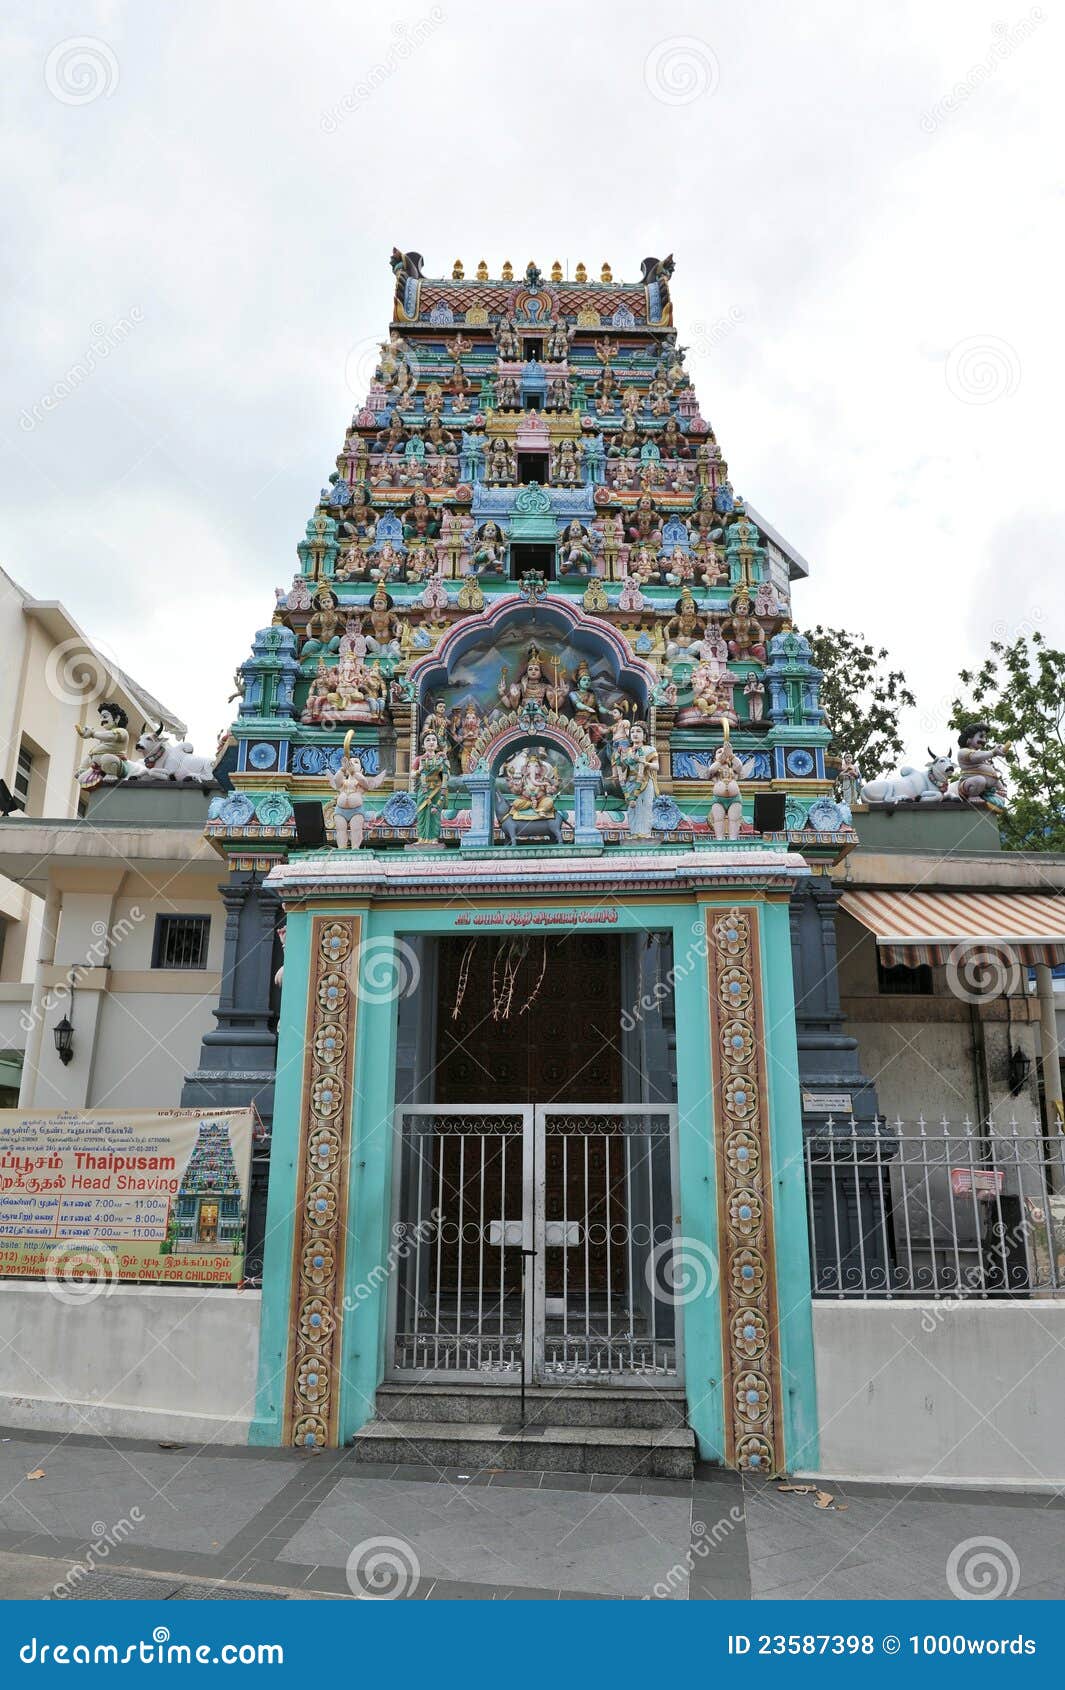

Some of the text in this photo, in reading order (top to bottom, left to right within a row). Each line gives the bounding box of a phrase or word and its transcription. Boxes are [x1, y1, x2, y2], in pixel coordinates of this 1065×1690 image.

[74, 1152, 176, 1174] Thaipusam
[71, 1175, 111, 1190] Head
[117, 1175, 179, 1194] Shaving
[138, 1269, 162, 1279] ONLY
[164, 1270, 183, 1281] FOR
[185, 1270, 232, 1281] CHILDREN
